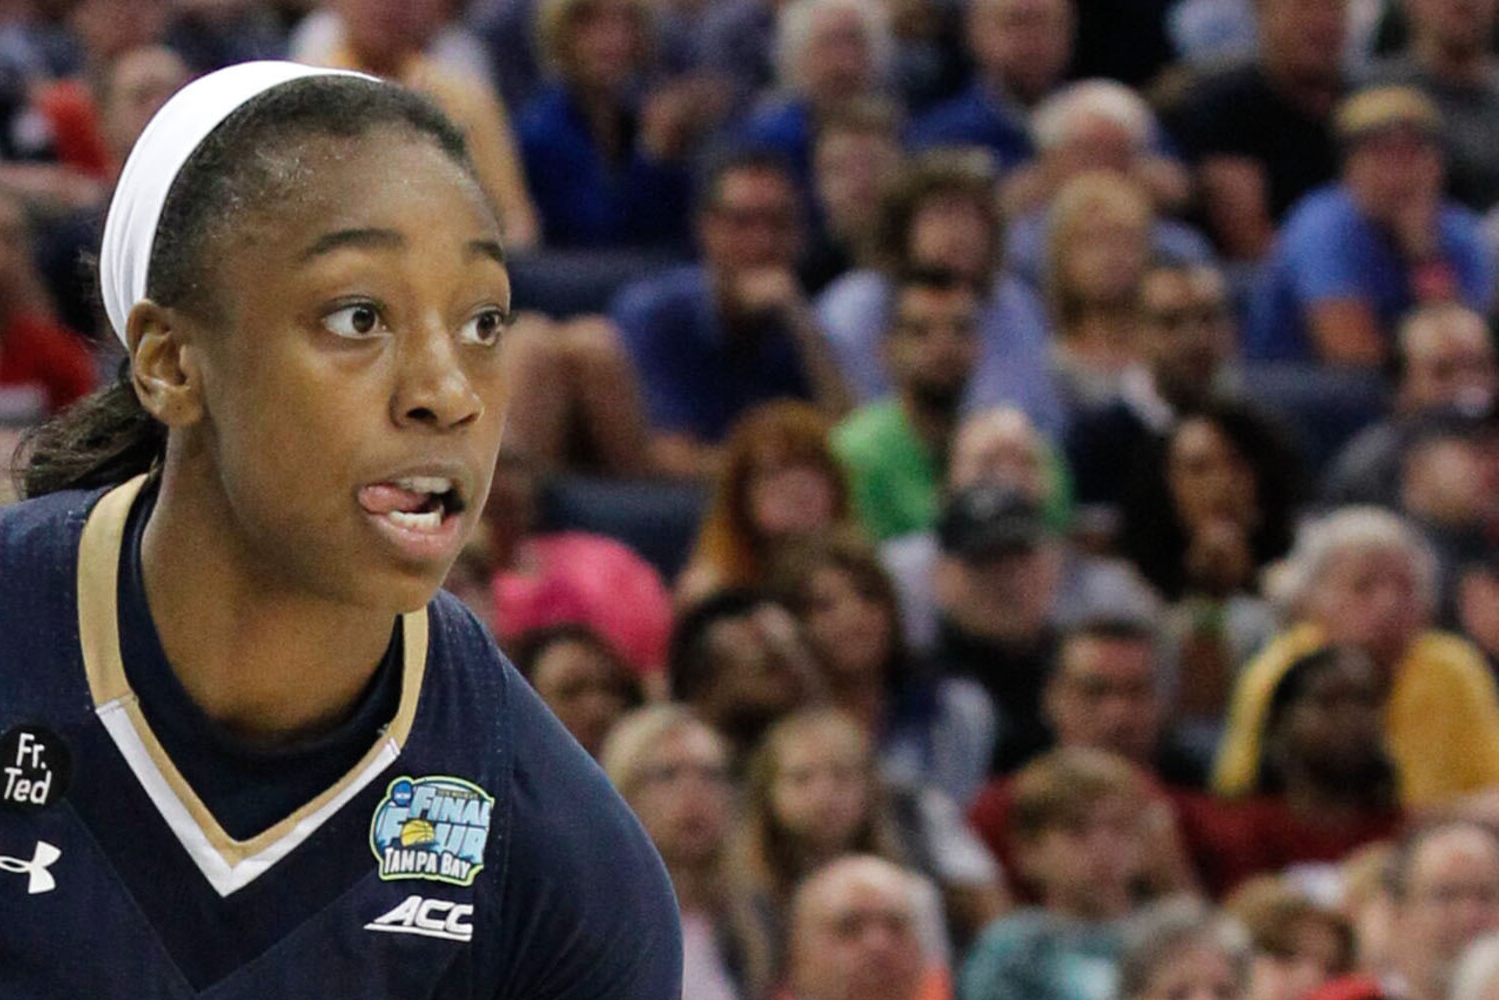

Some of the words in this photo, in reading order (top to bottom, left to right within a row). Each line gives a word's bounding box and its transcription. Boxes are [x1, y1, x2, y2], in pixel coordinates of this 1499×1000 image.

[15, 732, 47, 769] Fr.
[3, 767, 52, 805] Ted
[383, 847, 438, 874] TAMPA
[440, 850, 472, 880] BAY
[372, 895, 474, 936] ACC
